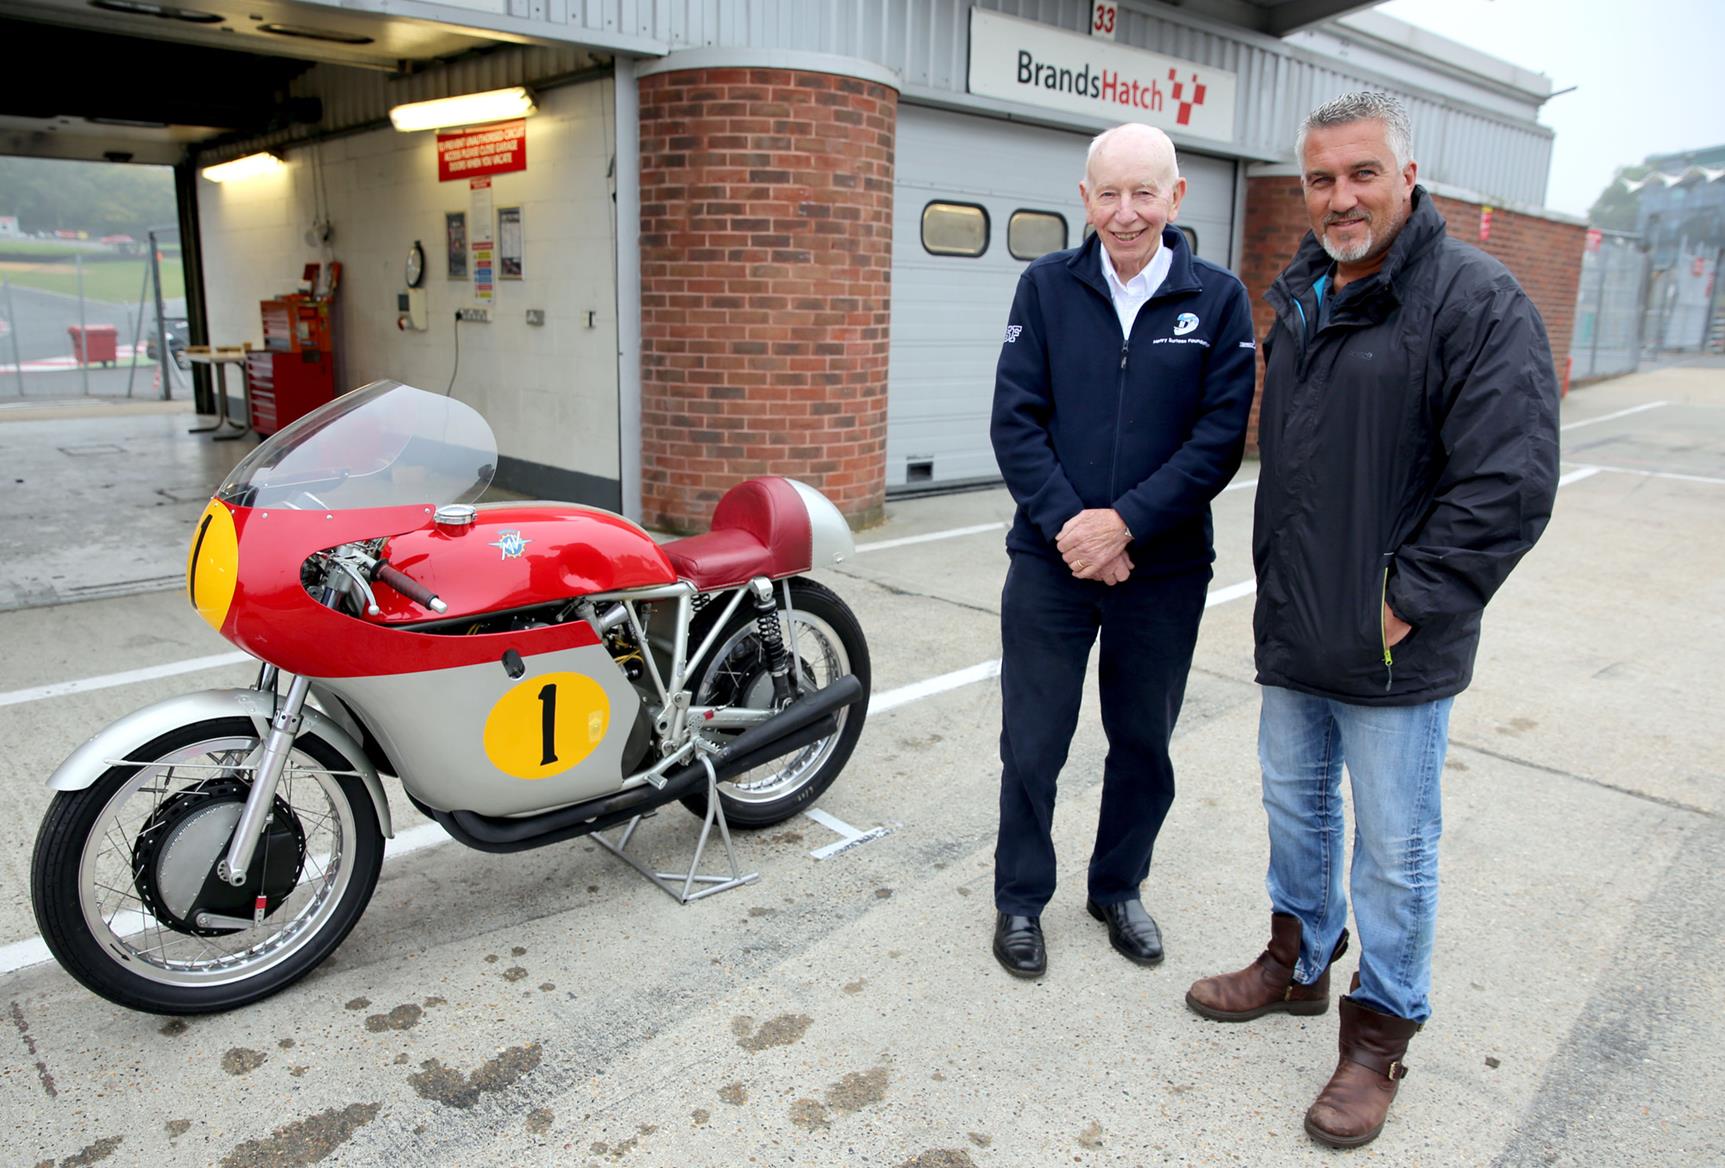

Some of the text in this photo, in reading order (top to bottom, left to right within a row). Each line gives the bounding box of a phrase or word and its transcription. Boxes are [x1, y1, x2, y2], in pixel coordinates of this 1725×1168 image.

[1094, 5, 1117, 33] 33
[1016, 49, 1163, 112] BrandsHatch
[189, 514, 213, 610] 1
[538, 683, 559, 766] 1
